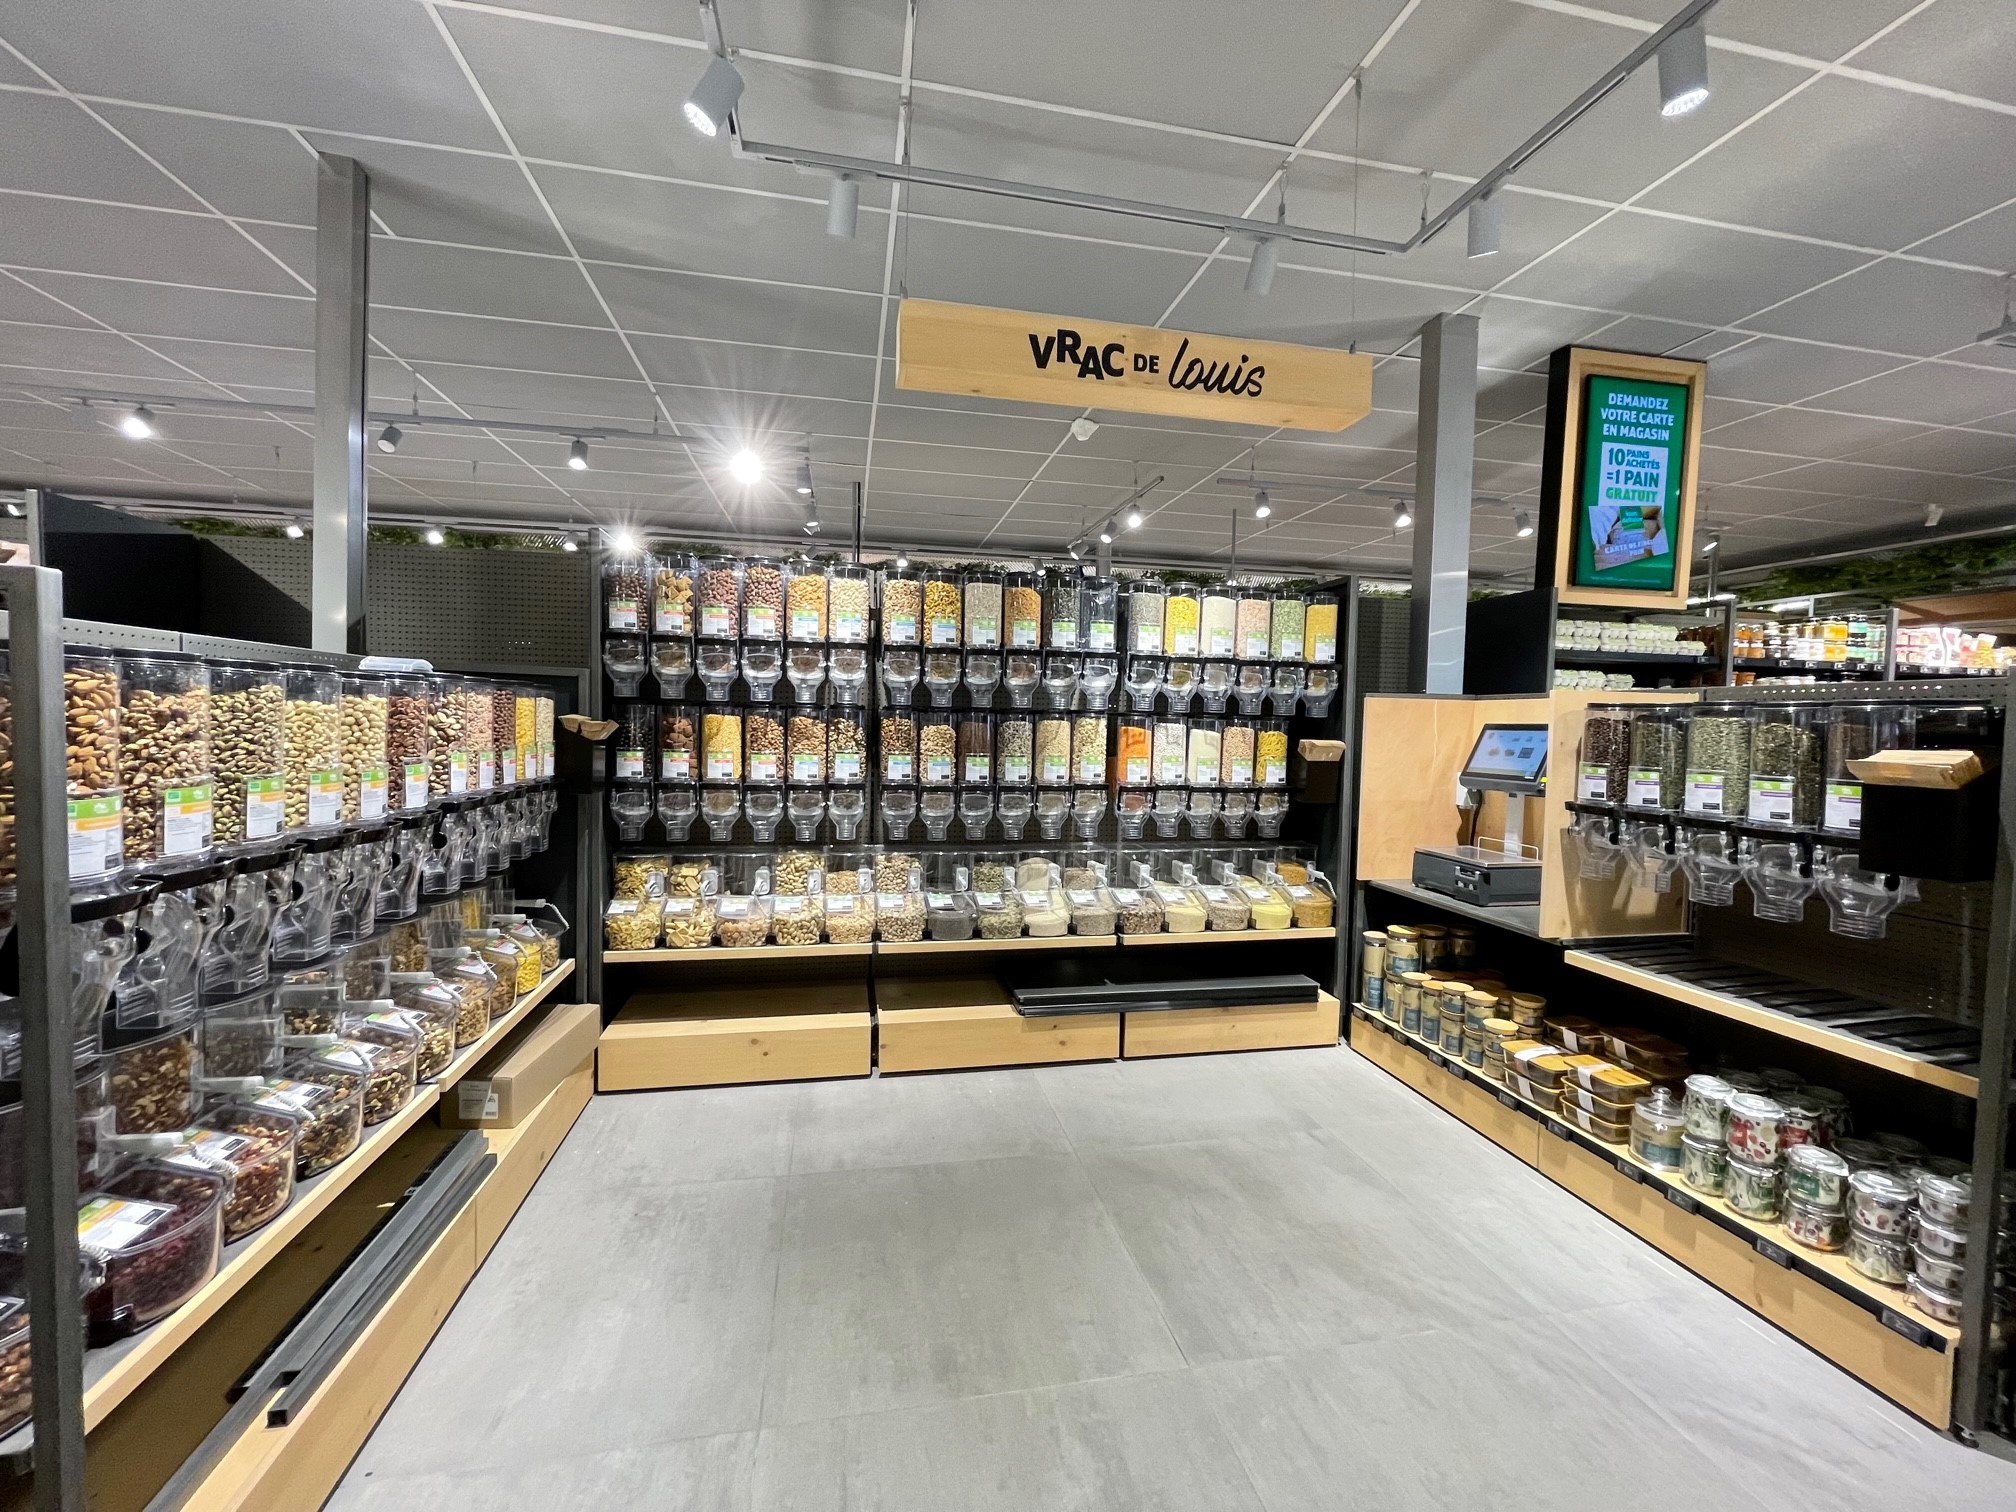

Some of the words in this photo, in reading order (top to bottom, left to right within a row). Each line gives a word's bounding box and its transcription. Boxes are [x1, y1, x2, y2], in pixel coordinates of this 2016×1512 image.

[1028, 329, 1125, 380] VRAC
[1134, 353, 1160, 373] DE
[1608, 393, 1668, 410] DEMANDEZ
[1600, 408, 1638, 423] VOTRE
[1639, 412, 1675, 426] CARTE
[1603, 423, 1617, 437] EN
[1620, 425, 1669, 441] MAGASIN
[1608, 447, 1626, 466] 10
[1626, 449, 1650, 459] PAINS
[1625, 459, 1660, 470] ACHETÉS
[1624, 470, 1660, 488] PAIN
[1605, 487, 1657, 503] GRATUIT
